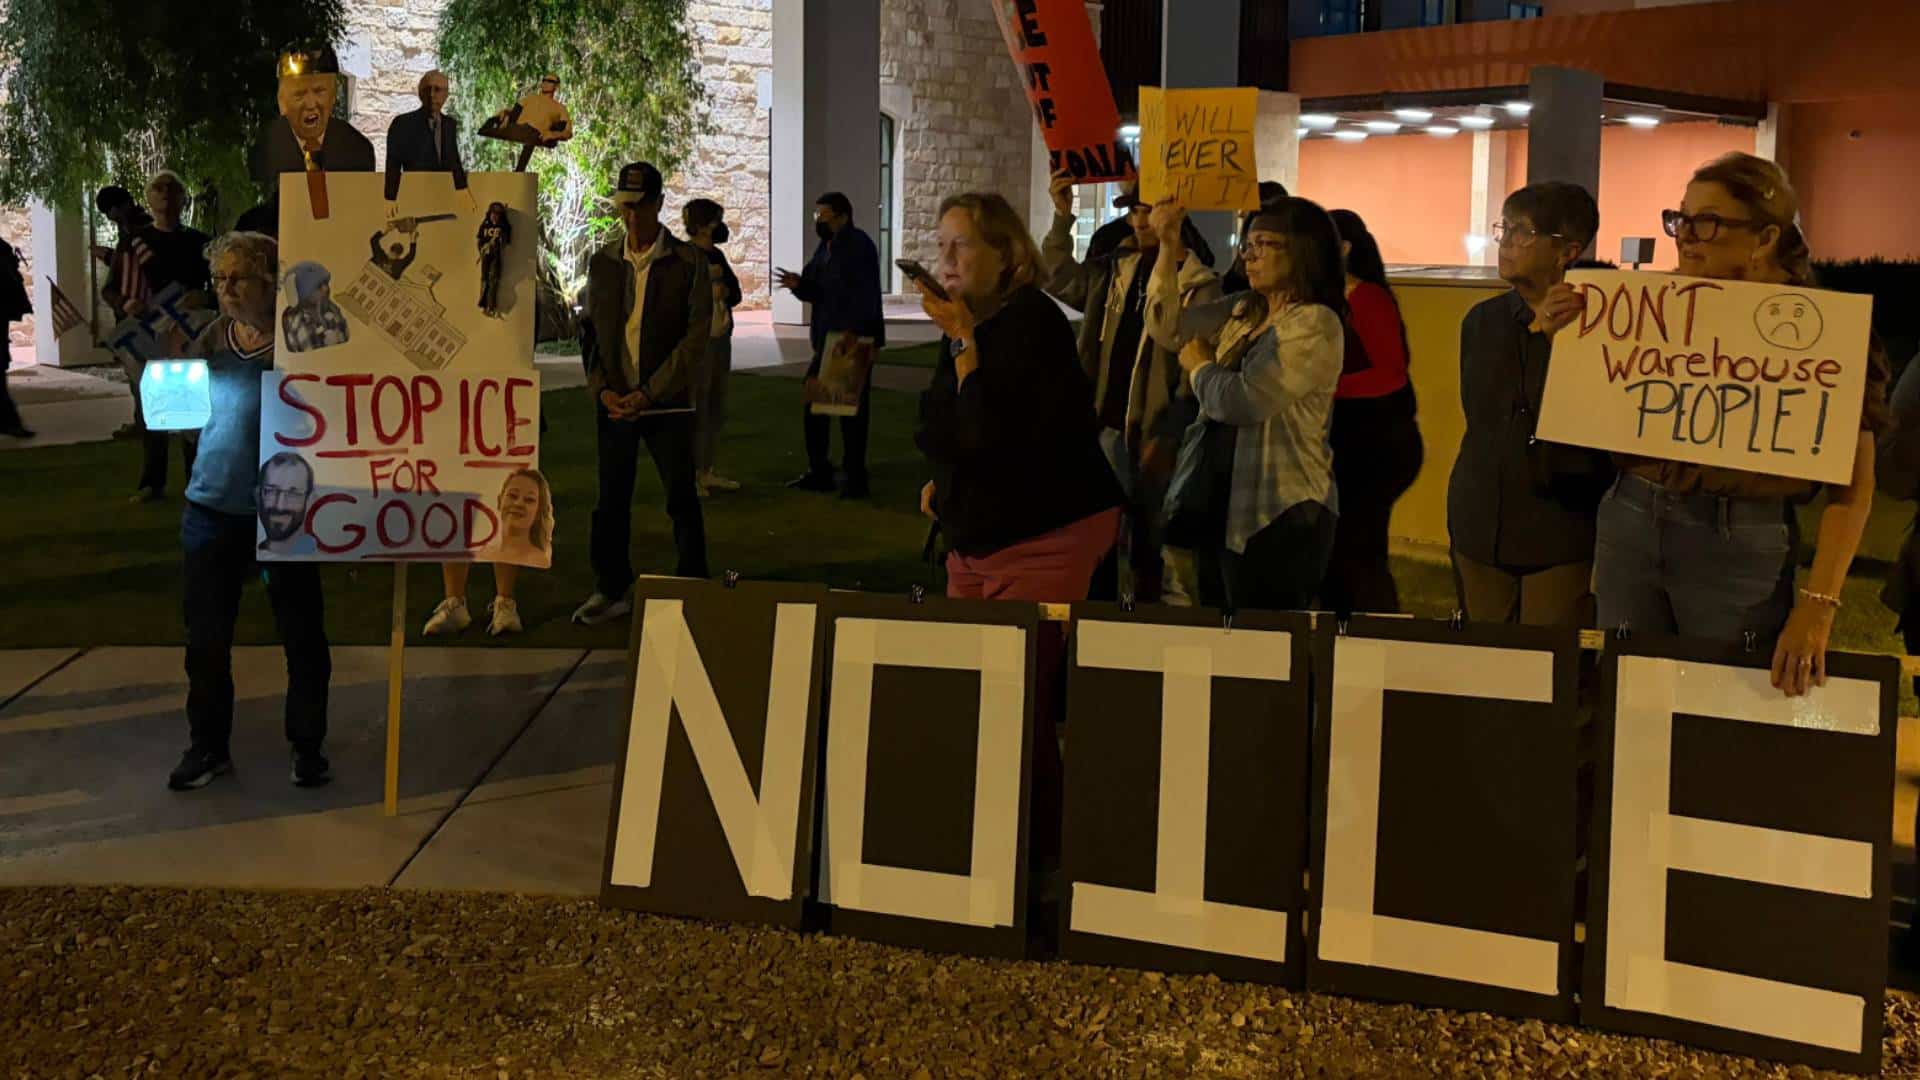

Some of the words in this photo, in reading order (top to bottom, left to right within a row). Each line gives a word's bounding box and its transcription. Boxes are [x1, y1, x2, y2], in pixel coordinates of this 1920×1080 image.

[1175, 103, 1249, 137] WILL
[1578, 281, 1724, 347] DON'T
[274, 374, 444, 448] STOP
[458, 378, 536, 457] ICE
[1624, 379, 1829, 456] PEOPLE!
[369, 457, 441, 498] FOR
[303, 492, 499, 554] GOOD
[610, 598, 1026, 928] NO
[1070, 619, 1880, 1054] ICE
